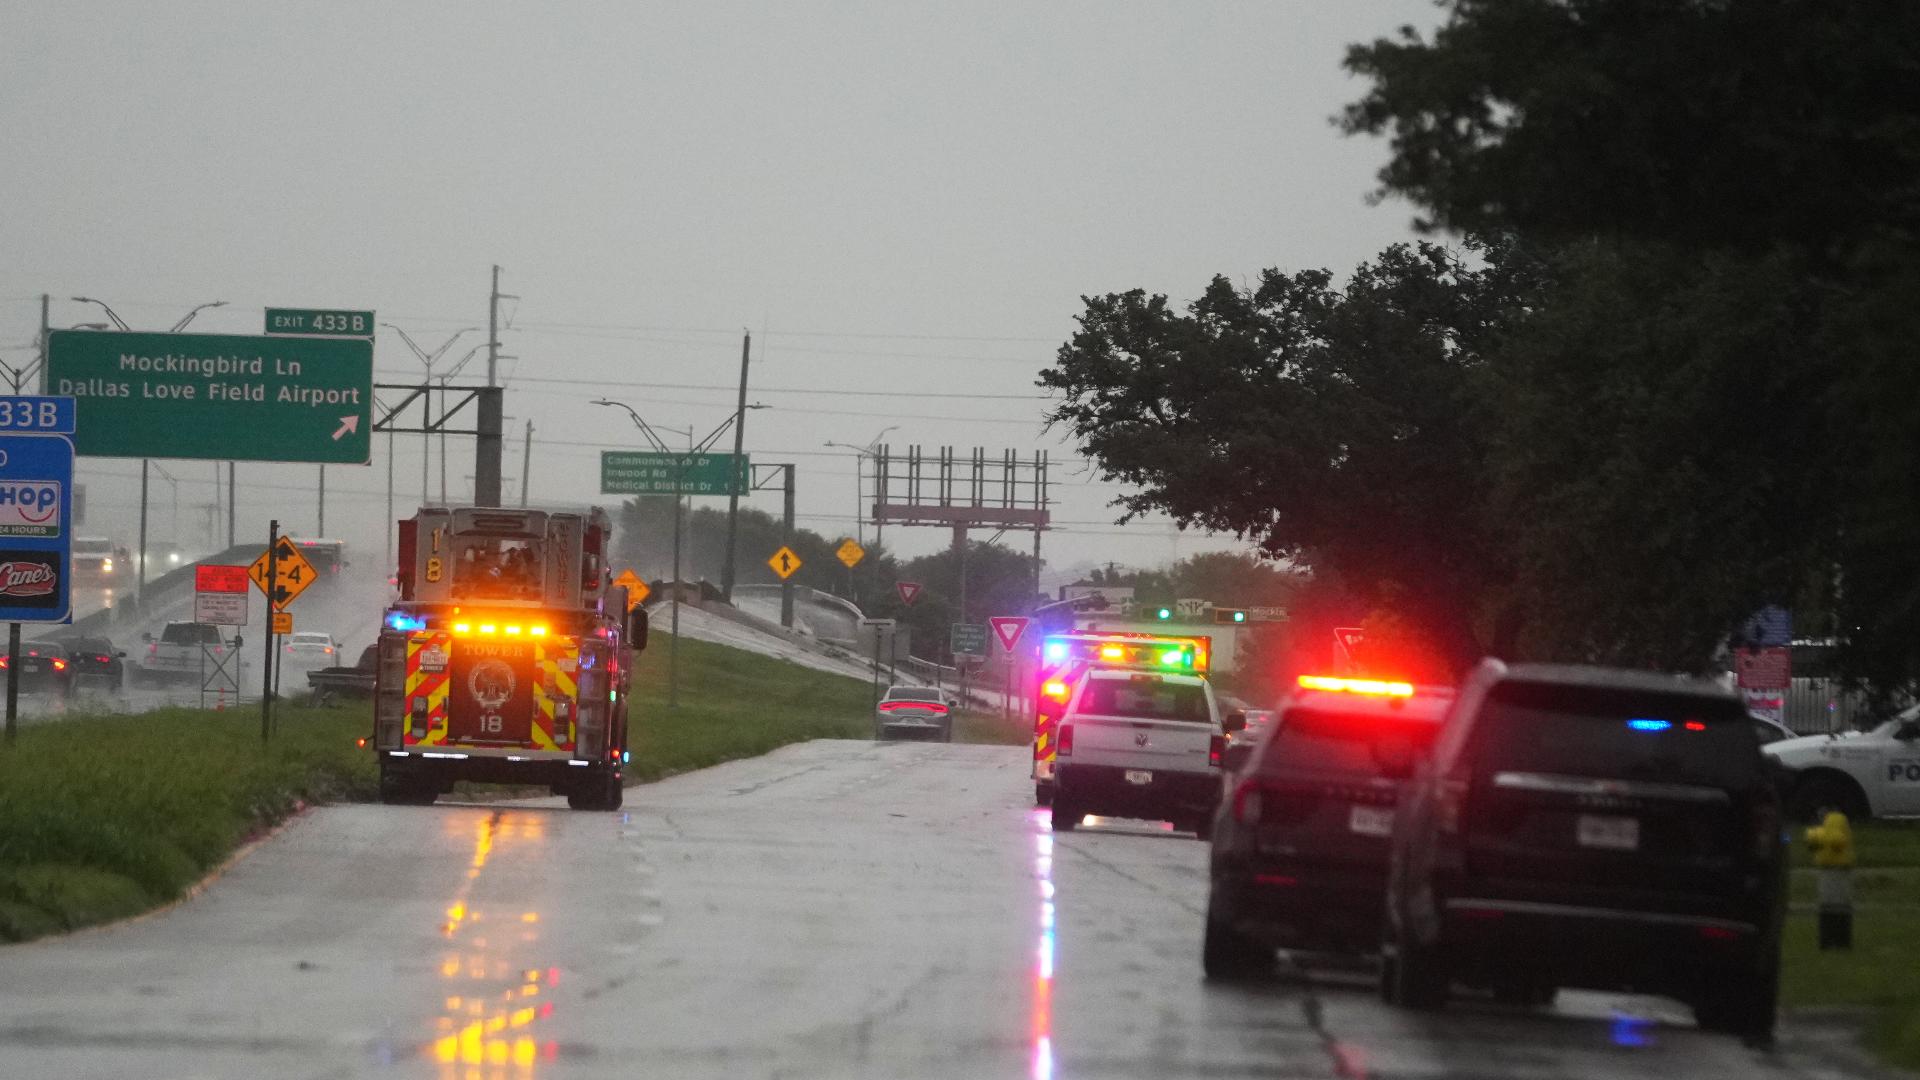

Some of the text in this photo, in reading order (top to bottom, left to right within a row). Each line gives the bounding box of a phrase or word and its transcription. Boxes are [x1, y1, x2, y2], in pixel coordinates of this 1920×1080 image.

[274, 316, 304, 328] EXIT
[119, 353, 301, 377] Mockingbird Ln
[58, 378, 360, 407] Dallas Love Field Airport
[652, 470, 667, 478] Rd
[607, 480, 649, 490] Medical
[654, 481, 694, 491] Distict
[700, 482, 712, 491] Dr
[11, 526, 48, 535] HOURS
[463, 644, 524, 657] TOWER
[479, 715, 503, 733] 18
